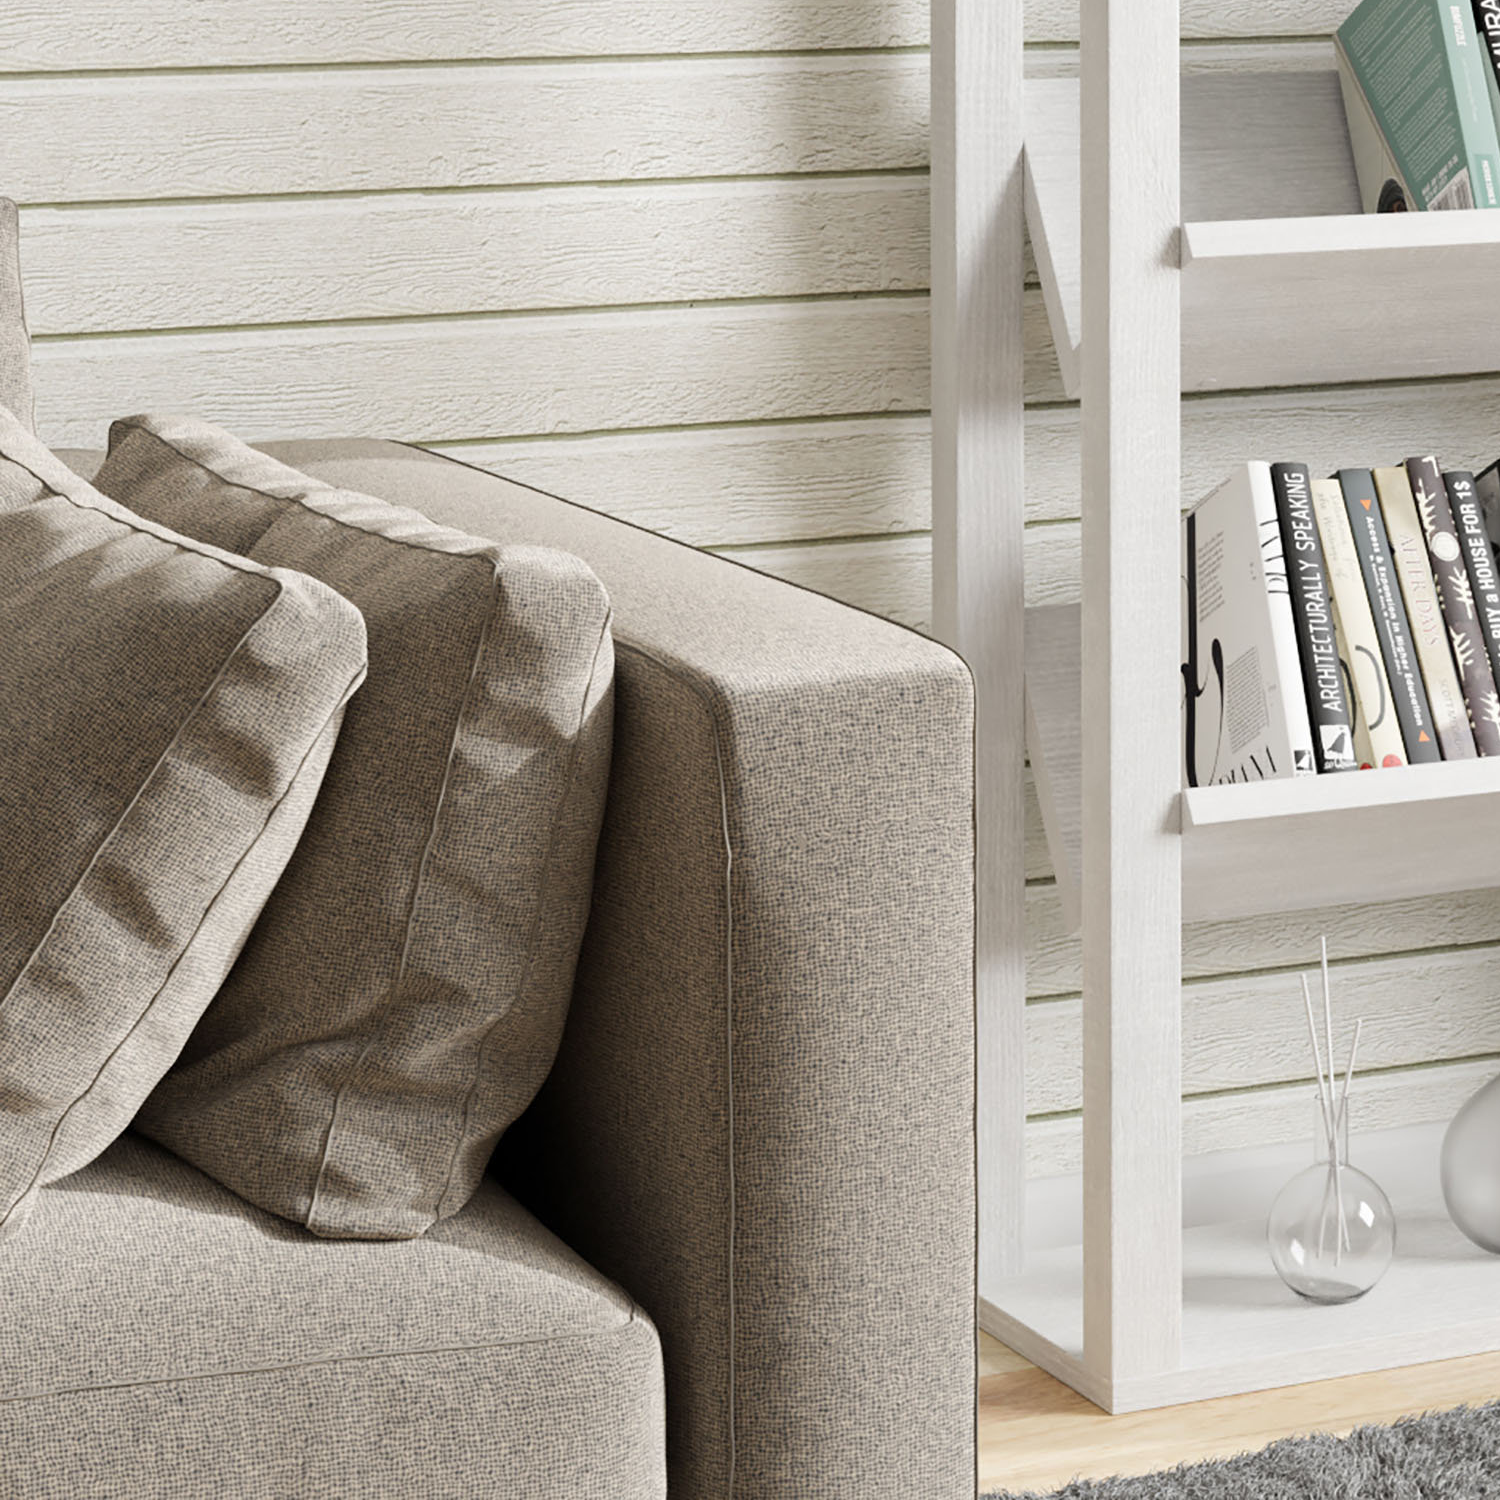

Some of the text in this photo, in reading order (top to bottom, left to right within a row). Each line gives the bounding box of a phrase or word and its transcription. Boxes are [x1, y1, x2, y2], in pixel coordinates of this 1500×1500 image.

[1283, 472, 1316, 552] SPEAKING
[1453, 480, 1473, 500] 1$
[1459, 503, 1482, 534] FOR
[1400, 534, 1439, 646] AFTER DAYS
[1468, 537, 1496, 590] HOUSE
[1365, 516, 1423, 726] Access & Expansion in Higher Education
[1485, 593, 1500, 604] a
[1298, 559, 1344, 713] ARCHITECTURALLY
